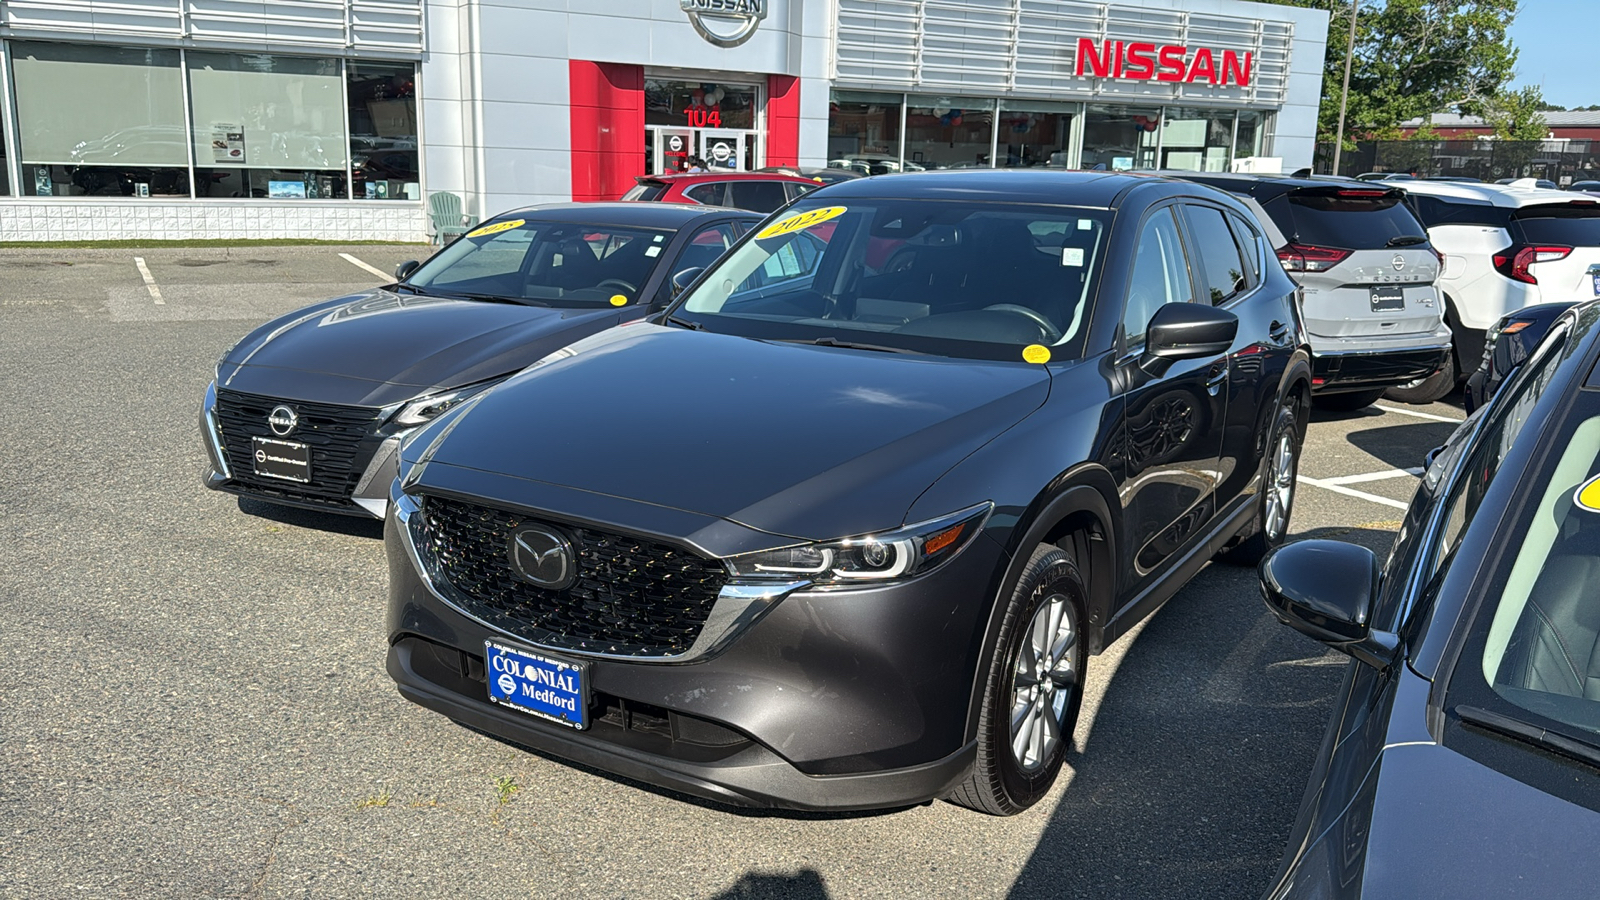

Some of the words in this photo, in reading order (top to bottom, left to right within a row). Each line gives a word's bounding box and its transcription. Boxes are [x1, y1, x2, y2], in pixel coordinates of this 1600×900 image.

[1075, 37, 1252, 87] NISSAN
[683, 103, 722, 129] 104
[768, 209, 832, 236] 2022
[268, 416, 297, 426] NISSAN
[493, 643, 518, 655] COLONIAL
[518, 650, 537, 660] NISSAN
[544, 657, 570, 669] MEDFORD
[492, 655, 579, 695] COLONIAL
[522, 682, 576, 712] Medford
